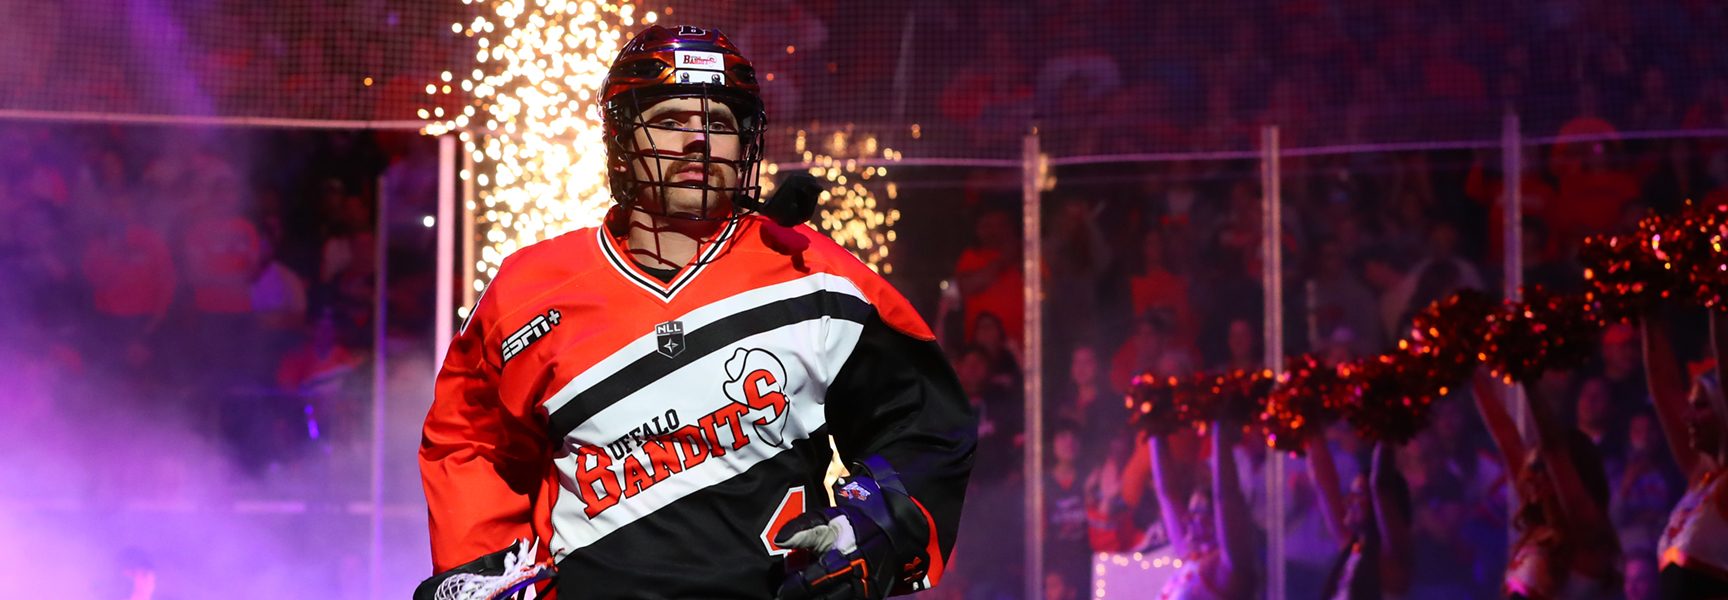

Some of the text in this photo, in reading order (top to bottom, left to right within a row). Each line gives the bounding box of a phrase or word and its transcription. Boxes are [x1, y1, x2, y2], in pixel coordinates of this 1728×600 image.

[501, 308, 562, 362] ESPN+
[657, 323, 681, 334] NLL
[575, 369, 787, 520] BANDITS
